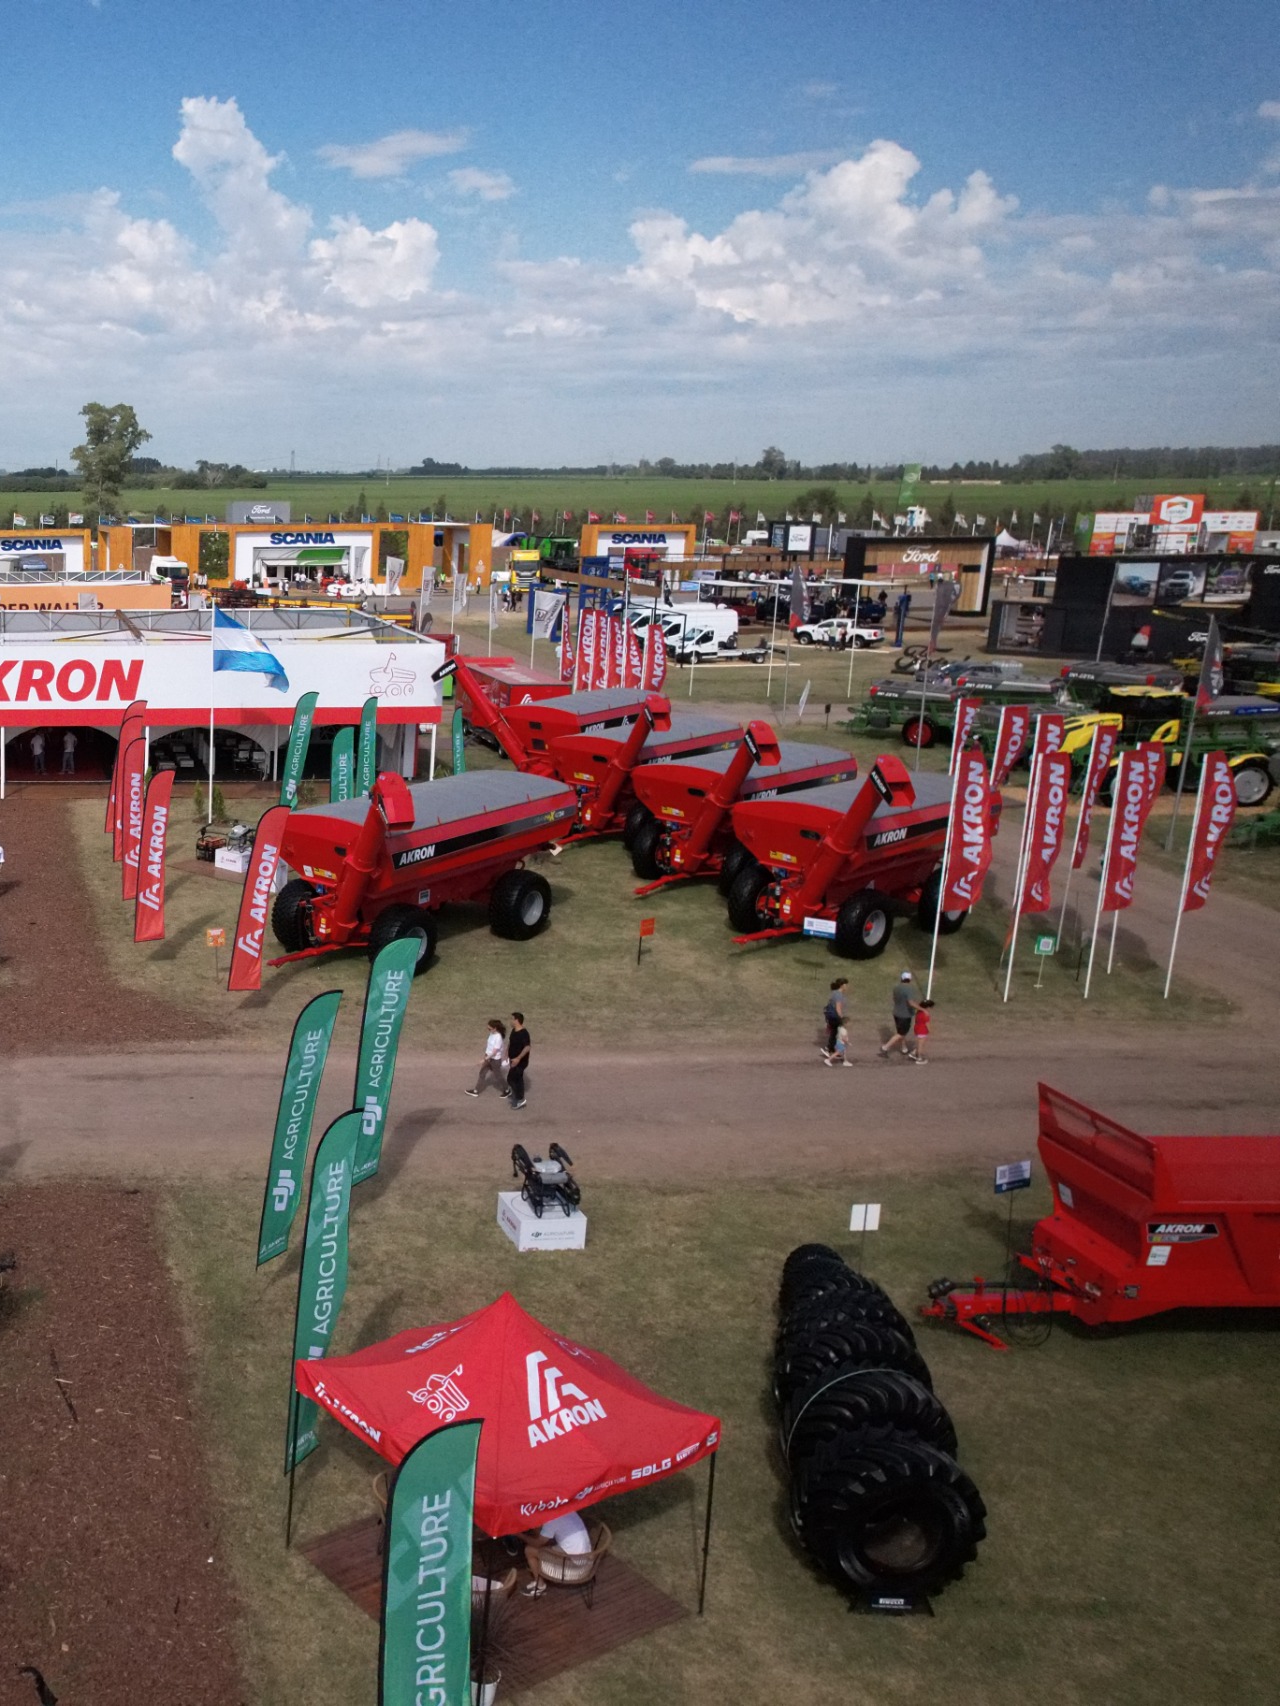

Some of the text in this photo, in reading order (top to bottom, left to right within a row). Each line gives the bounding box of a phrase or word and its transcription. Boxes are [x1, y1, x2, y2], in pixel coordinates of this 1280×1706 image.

[251, 505, 271, 514] Ford
[1, 539, 63, 551] SCANIA
[270, 532, 335, 545] SCANIA
[611, 533, 667, 544] SCANIA
[902, 545, 939, 563] Ford
[582, 614, 594, 664] AKRON
[651, 630, 664, 687] AKRON
[291, 713, 309, 776] AGRICULTURE
[362, 720, 372, 787] AGRICULTURE
[1003, 715, 1024, 767] RON
[338, 753, 348, 801] CULTURE
[871, 770, 887, 794] AKRON
[128, 772, 142, 839] AKRON
[962, 760, 984, 866] AKRON
[1041, 763, 1065, 863] AKRON
[1120, 760, 1145, 862] AKRON
[147, 805, 168, 878] AKRON
[399, 845, 436, 866] AKRON
[874, 828, 908, 847] AKRON
[250, 844, 278, 923] AKRON
[368, 969, 404, 1088] AGRICULTURE
[282, 1028, 323, 1161] AGRICULTURE
[312, 1159, 345, 1335] AGRICULTURE
[1154, 1223, 1205, 1234] AKRON
[527, 1397, 608, 1449] AKRON
[520, 1495, 569, 1517] Kubota
[631, 1457, 672, 1480] SDLG
